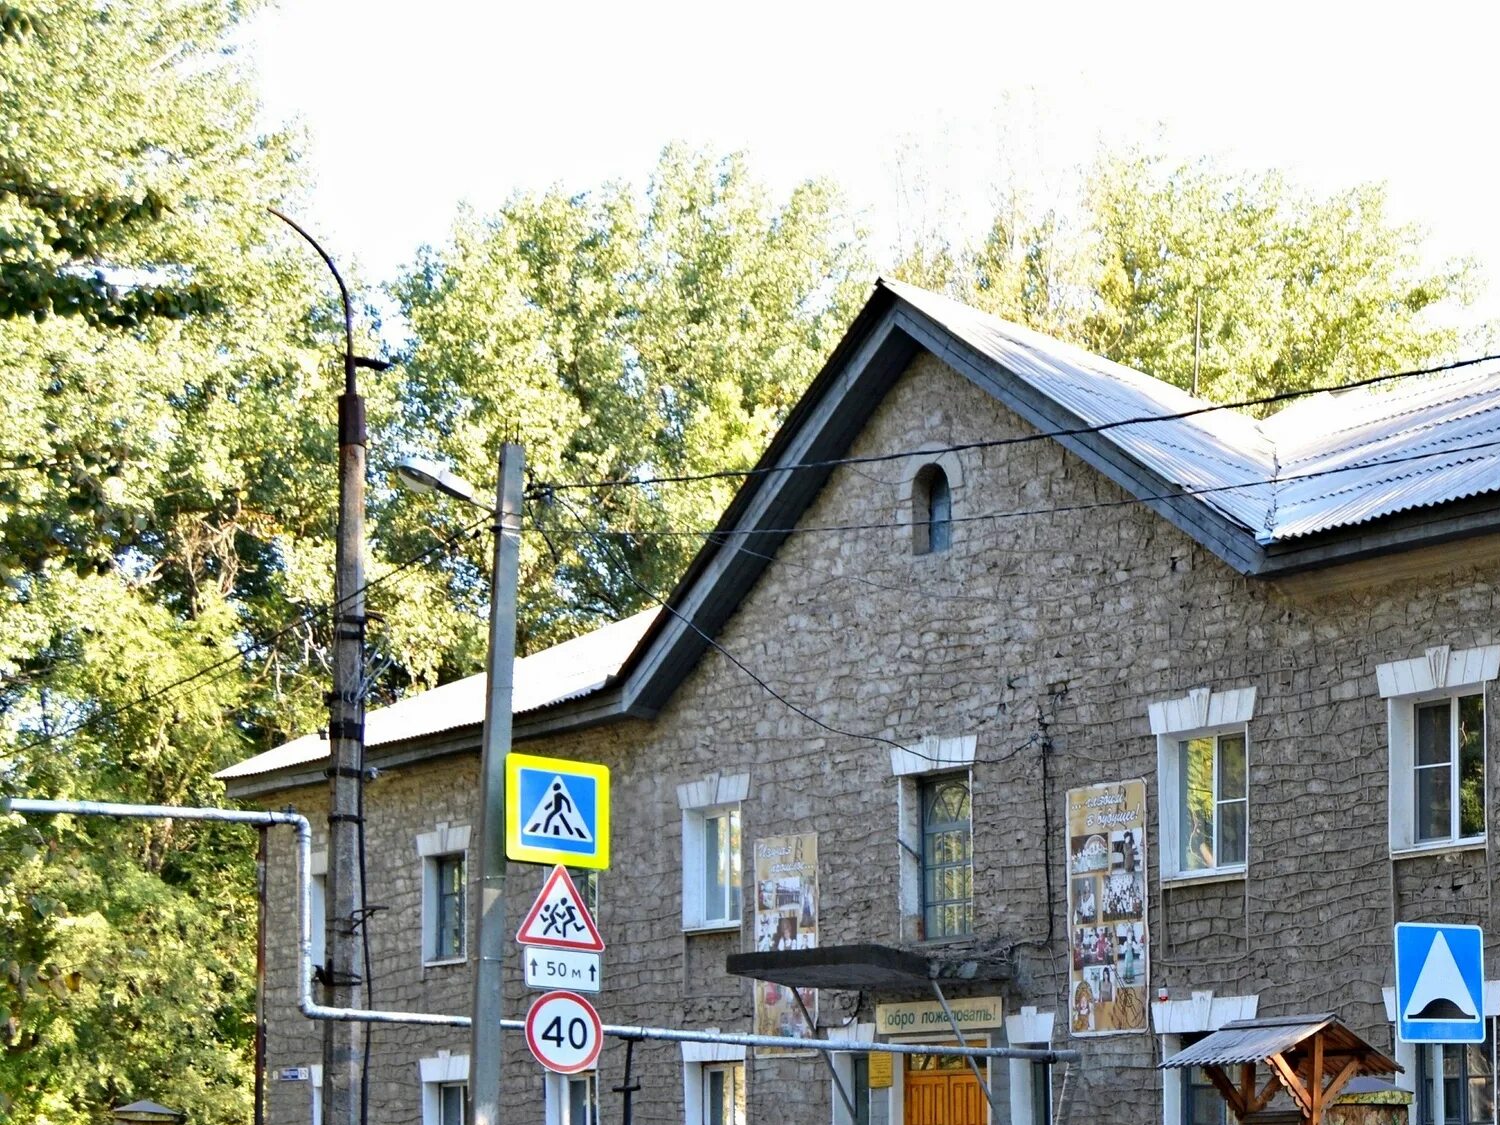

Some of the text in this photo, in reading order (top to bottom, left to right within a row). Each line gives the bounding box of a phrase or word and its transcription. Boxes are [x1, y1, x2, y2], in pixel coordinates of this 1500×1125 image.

[546, 961, 567, 977] 50
[884, 1008, 915, 1029] обро
[541, 1015, 588, 1050] 40
